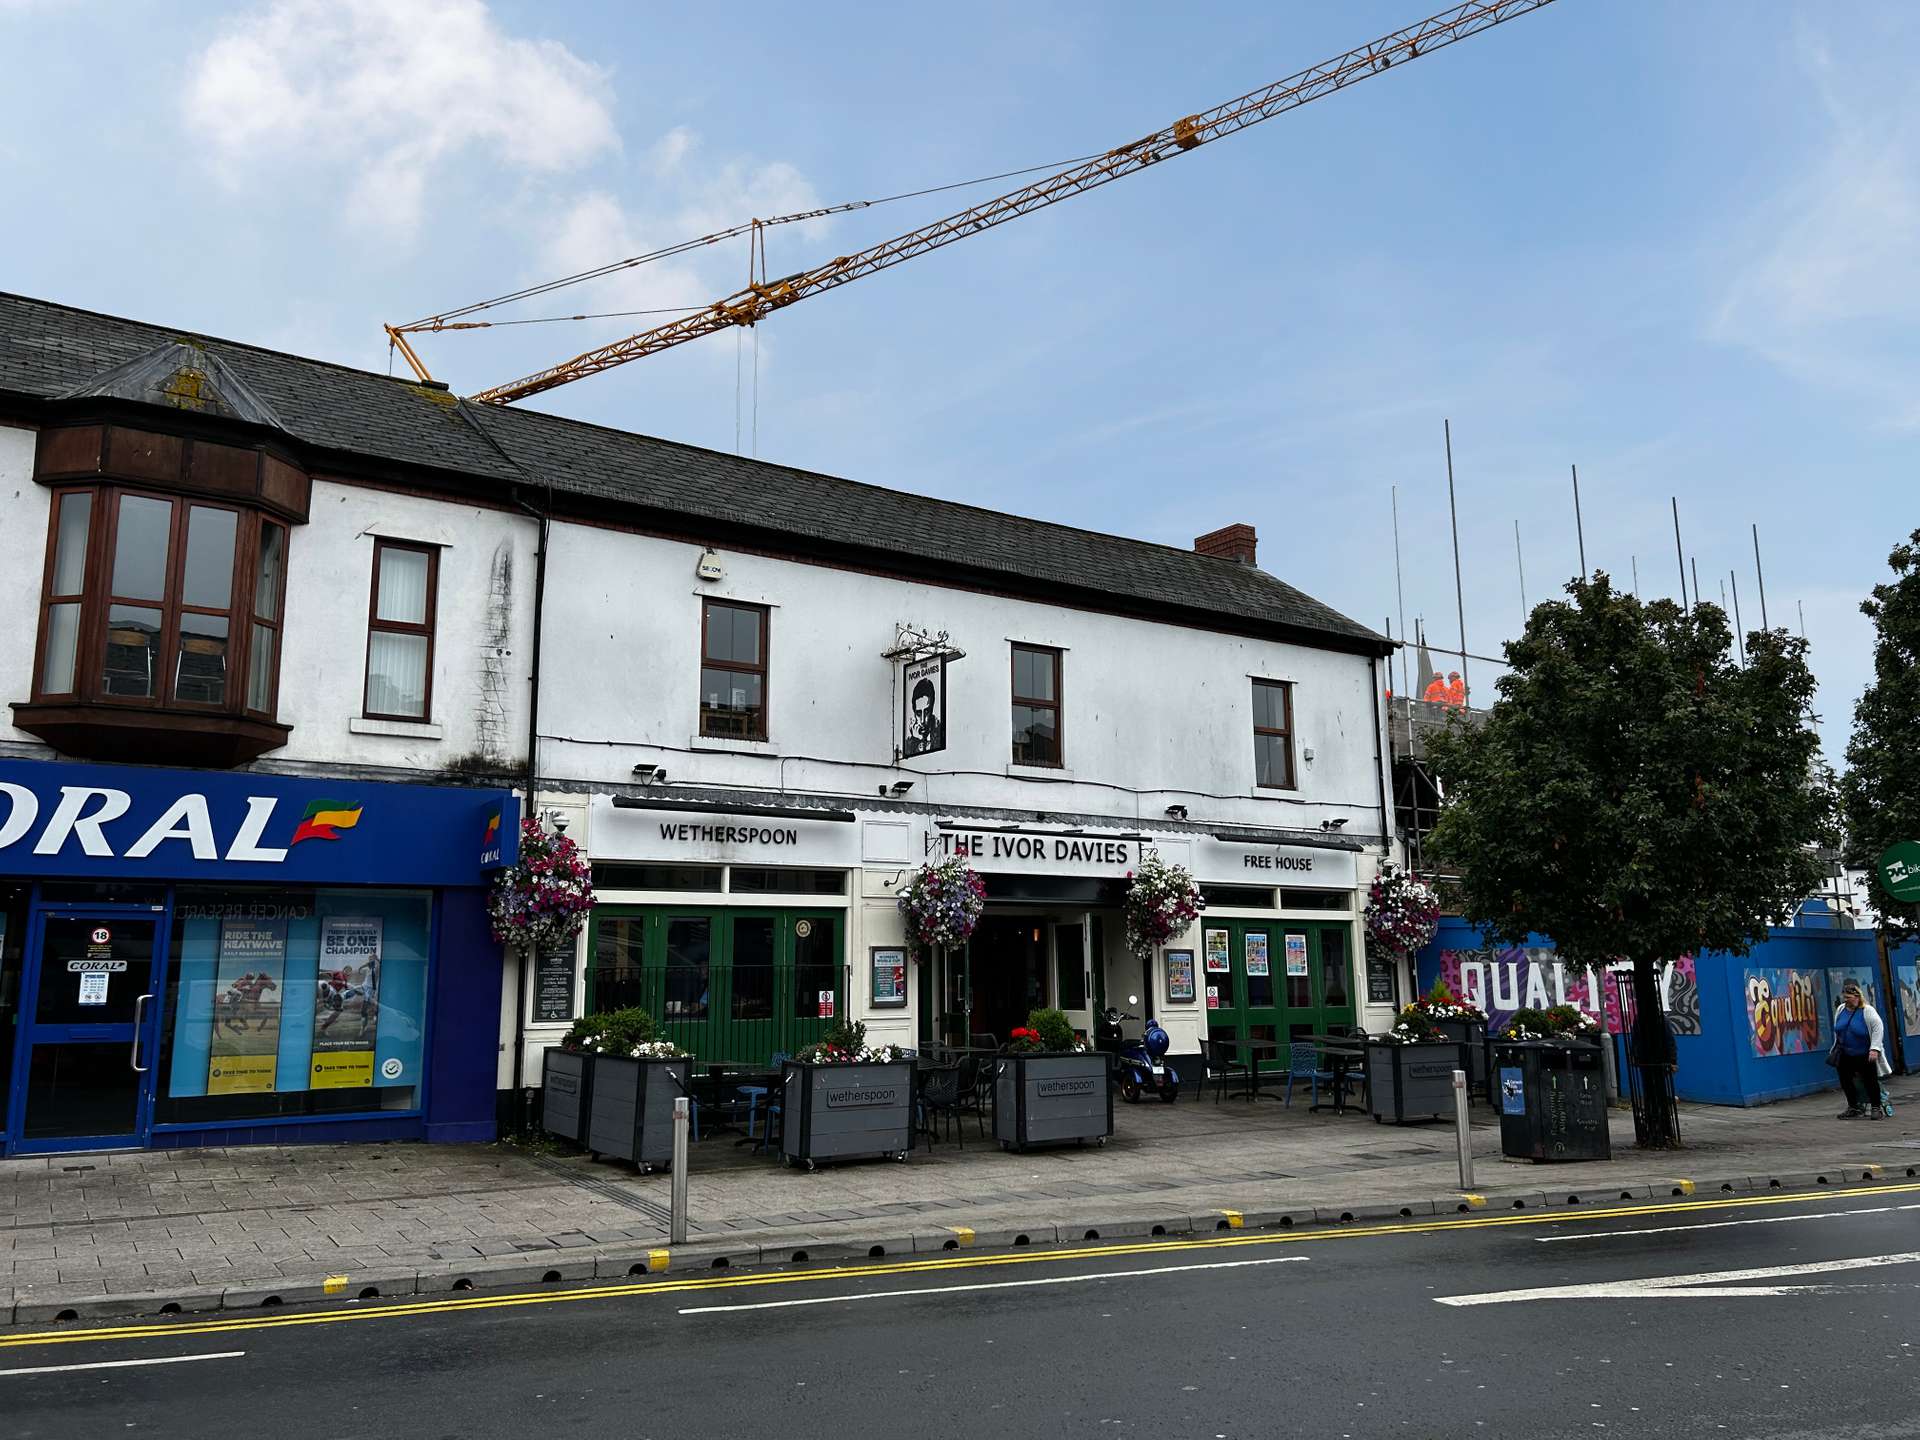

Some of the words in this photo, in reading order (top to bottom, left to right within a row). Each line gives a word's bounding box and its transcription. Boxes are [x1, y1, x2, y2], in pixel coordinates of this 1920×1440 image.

[660, 823, 797, 845] WETHERSPOON
[939, 833, 984, 857] THE
[993, 836, 1047, 860] IVOR
[1055, 840, 1128, 864] DAVIES
[1244, 855, 1272, 869] FREE
[1275, 857, 1313, 871] HOUSE
[94, 931, 107, 941] 18
[224, 931, 250, 940] RIDE
[251, 931, 273, 940] THE
[224, 940, 283, 949] HEATWAVE
[326, 936, 345, 946] BE
[346, 936, 377, 946] ONE
[325, 946, 377, 954] CHAMPION
[69, 961, 120, 971] CORAL
[1040, 1079, 1095, 1093] wetherspoon
[829, 1088, 895, 1103] wetherspoon
